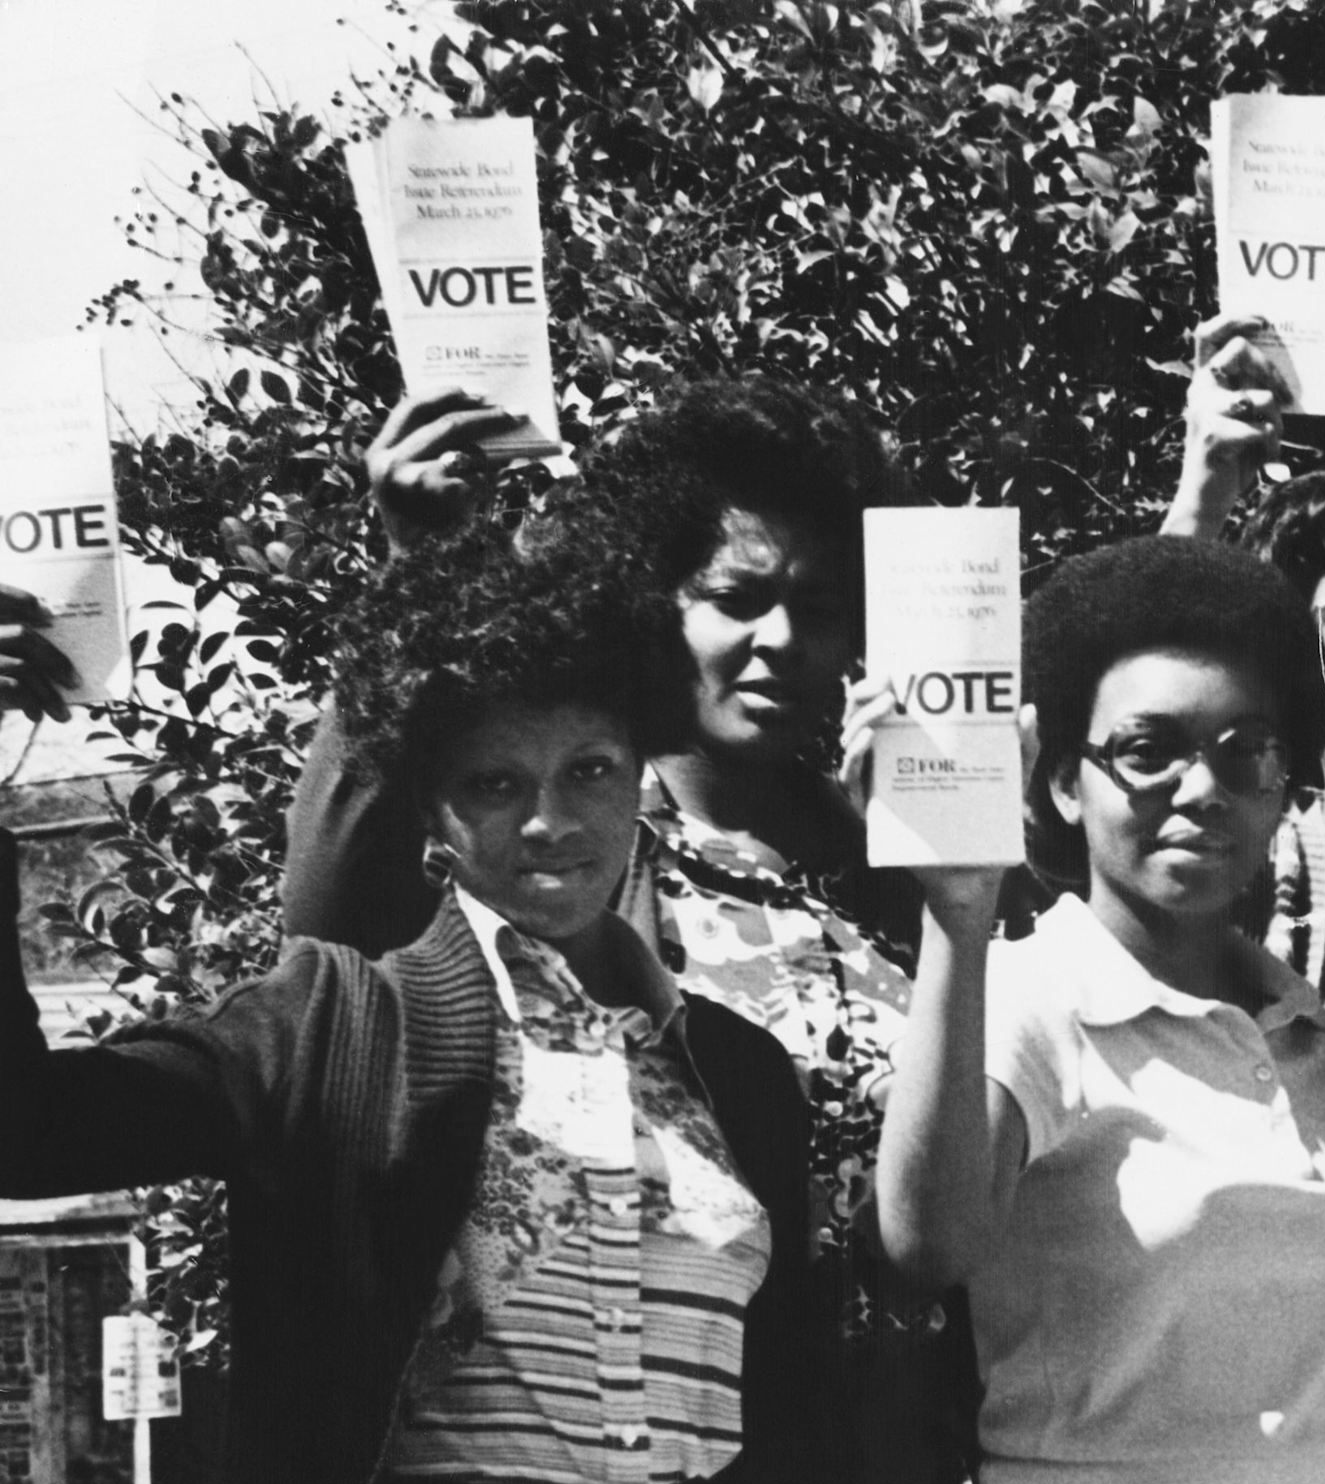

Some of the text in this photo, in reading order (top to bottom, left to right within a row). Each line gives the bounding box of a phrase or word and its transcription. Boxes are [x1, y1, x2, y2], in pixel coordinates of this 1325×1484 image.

[408, 265, 537, 308] VOTE
[0, 504, 110, 553] OTE
[888, 670, 1015, 716] VOTE
